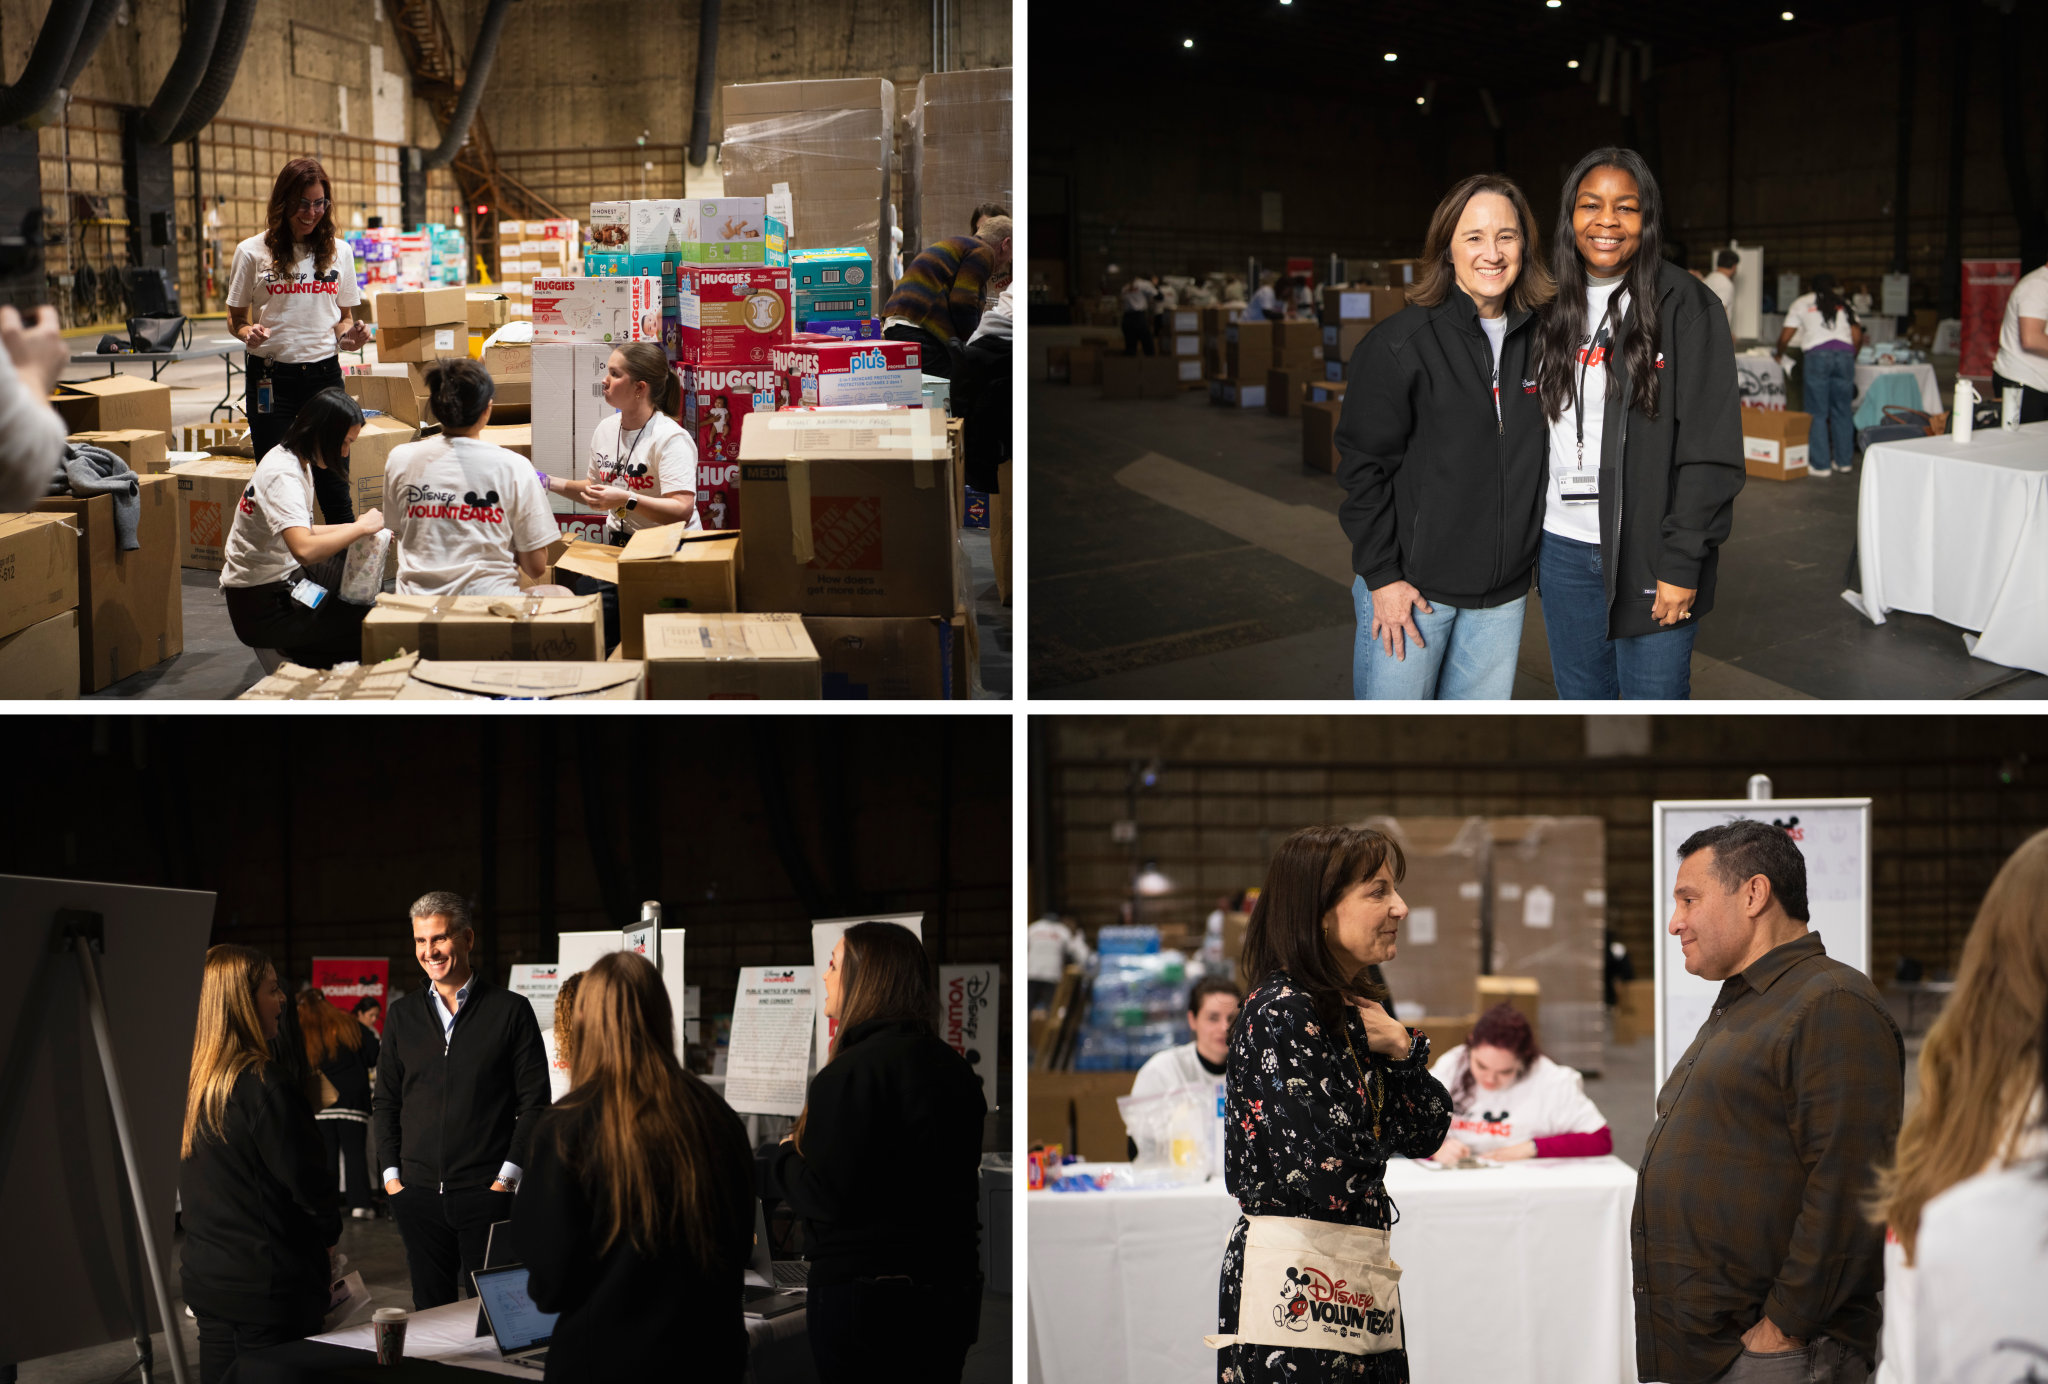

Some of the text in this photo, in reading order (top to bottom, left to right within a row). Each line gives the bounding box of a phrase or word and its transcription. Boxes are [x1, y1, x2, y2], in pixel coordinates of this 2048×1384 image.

[708, 246, 718, 258] 5
[534, 280, 575, 291] HUGGIES
[701, 273, 751, 285] HUGGIES
[632, 277, 640, 342] HUGGIES
[623, 331, 629, 340] 3
[773, 350, 819, 374] HUGGIES
[851, 348, 886, 374] plus
[802, 374, 818, 392] plus
[403, 484, 456, 508] Disney
[191, 502, 221, 544] HOME
[408, 504, 505, 524] VOLUNTEARS
[813, 497, 881, 568] HOME
[818, 574, 875, 584] How doers
[807, 585, 824, 595] get
[827, 587, 854, 595] more
[321, 983, 384, 997] VOLUNTEARS
[960, 970, 990, 1040] Disney
[1304, 1267, 1374, 1317] Disney
[1322, 1325, 1338, 1335] Disney
